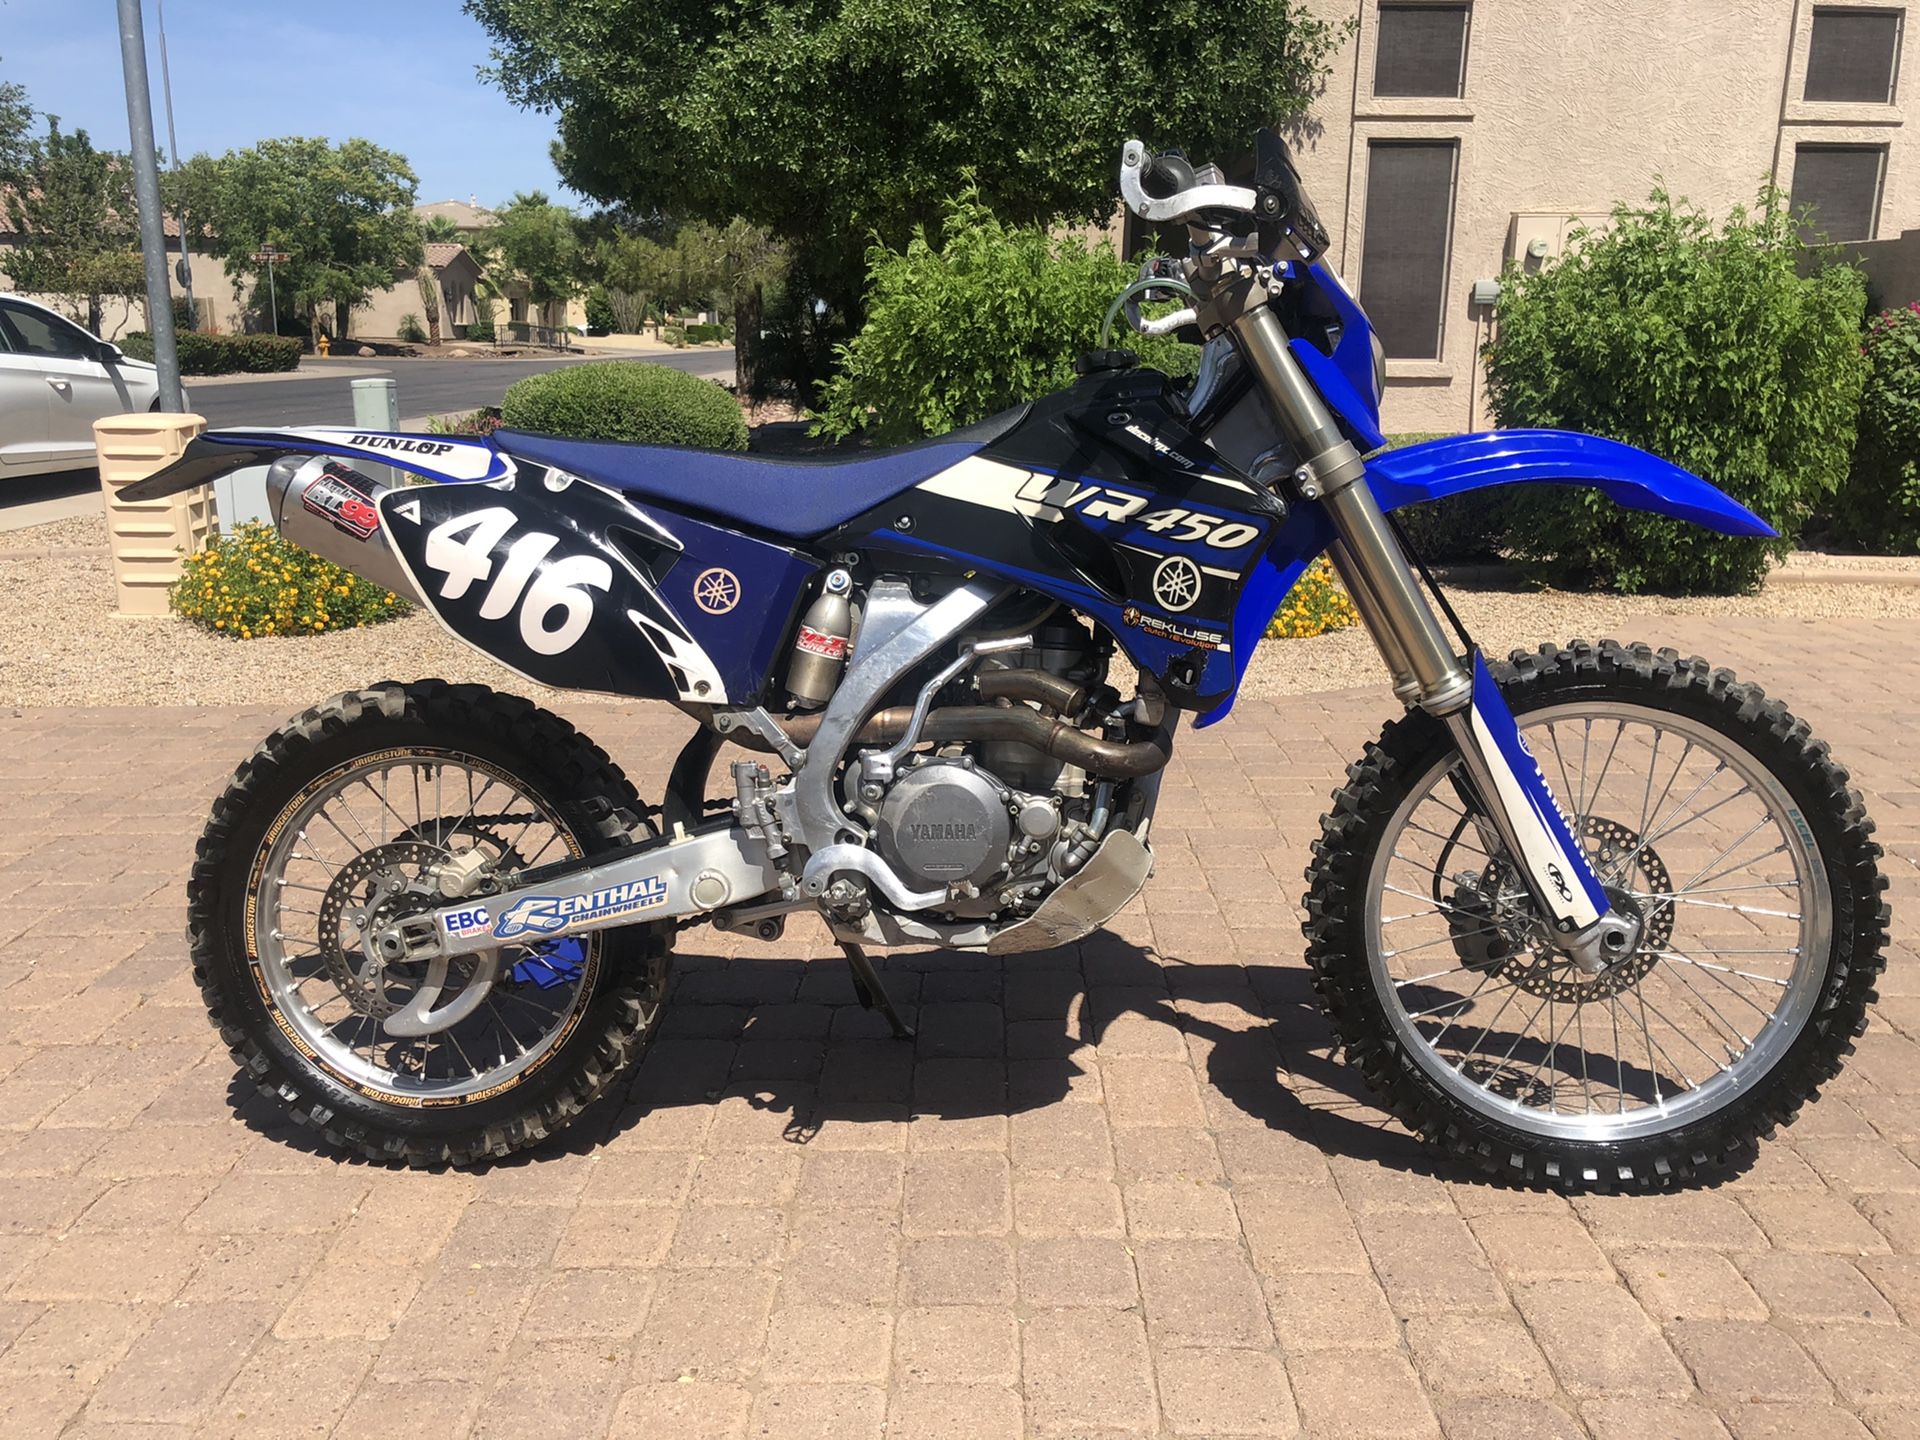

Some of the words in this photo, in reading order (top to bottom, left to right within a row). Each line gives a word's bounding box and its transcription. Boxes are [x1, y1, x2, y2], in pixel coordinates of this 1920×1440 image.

[347, 435, 454, 456] DUNLOP
[1136, 508, 1259, 549] 450
[425, 506, 613, 656] 416
[1139, 615, 1223, 644] REKLUSE
[1143, 625, 1167, 638] clutch
[352, 749, 412, 768] BRIDGESTONE
[265, 791, 307, 846] BRIDGESTONE
[910, 823, 977, 841] YAMAHA
[1788, 808, 1816, 850] EXCEL
[445, 907, 490, 932] EBC
[571, 896, 665, 923] CHAINWHEELS
[246, 893, 258, 958] BRIDGESTONE
[271, 1008, 318, 1061] BRIDGESTONE
[360, 1085, 421, 1107] BRIDGESTONE
[466, 1075, 521, 1103] BRIDGESTONE
